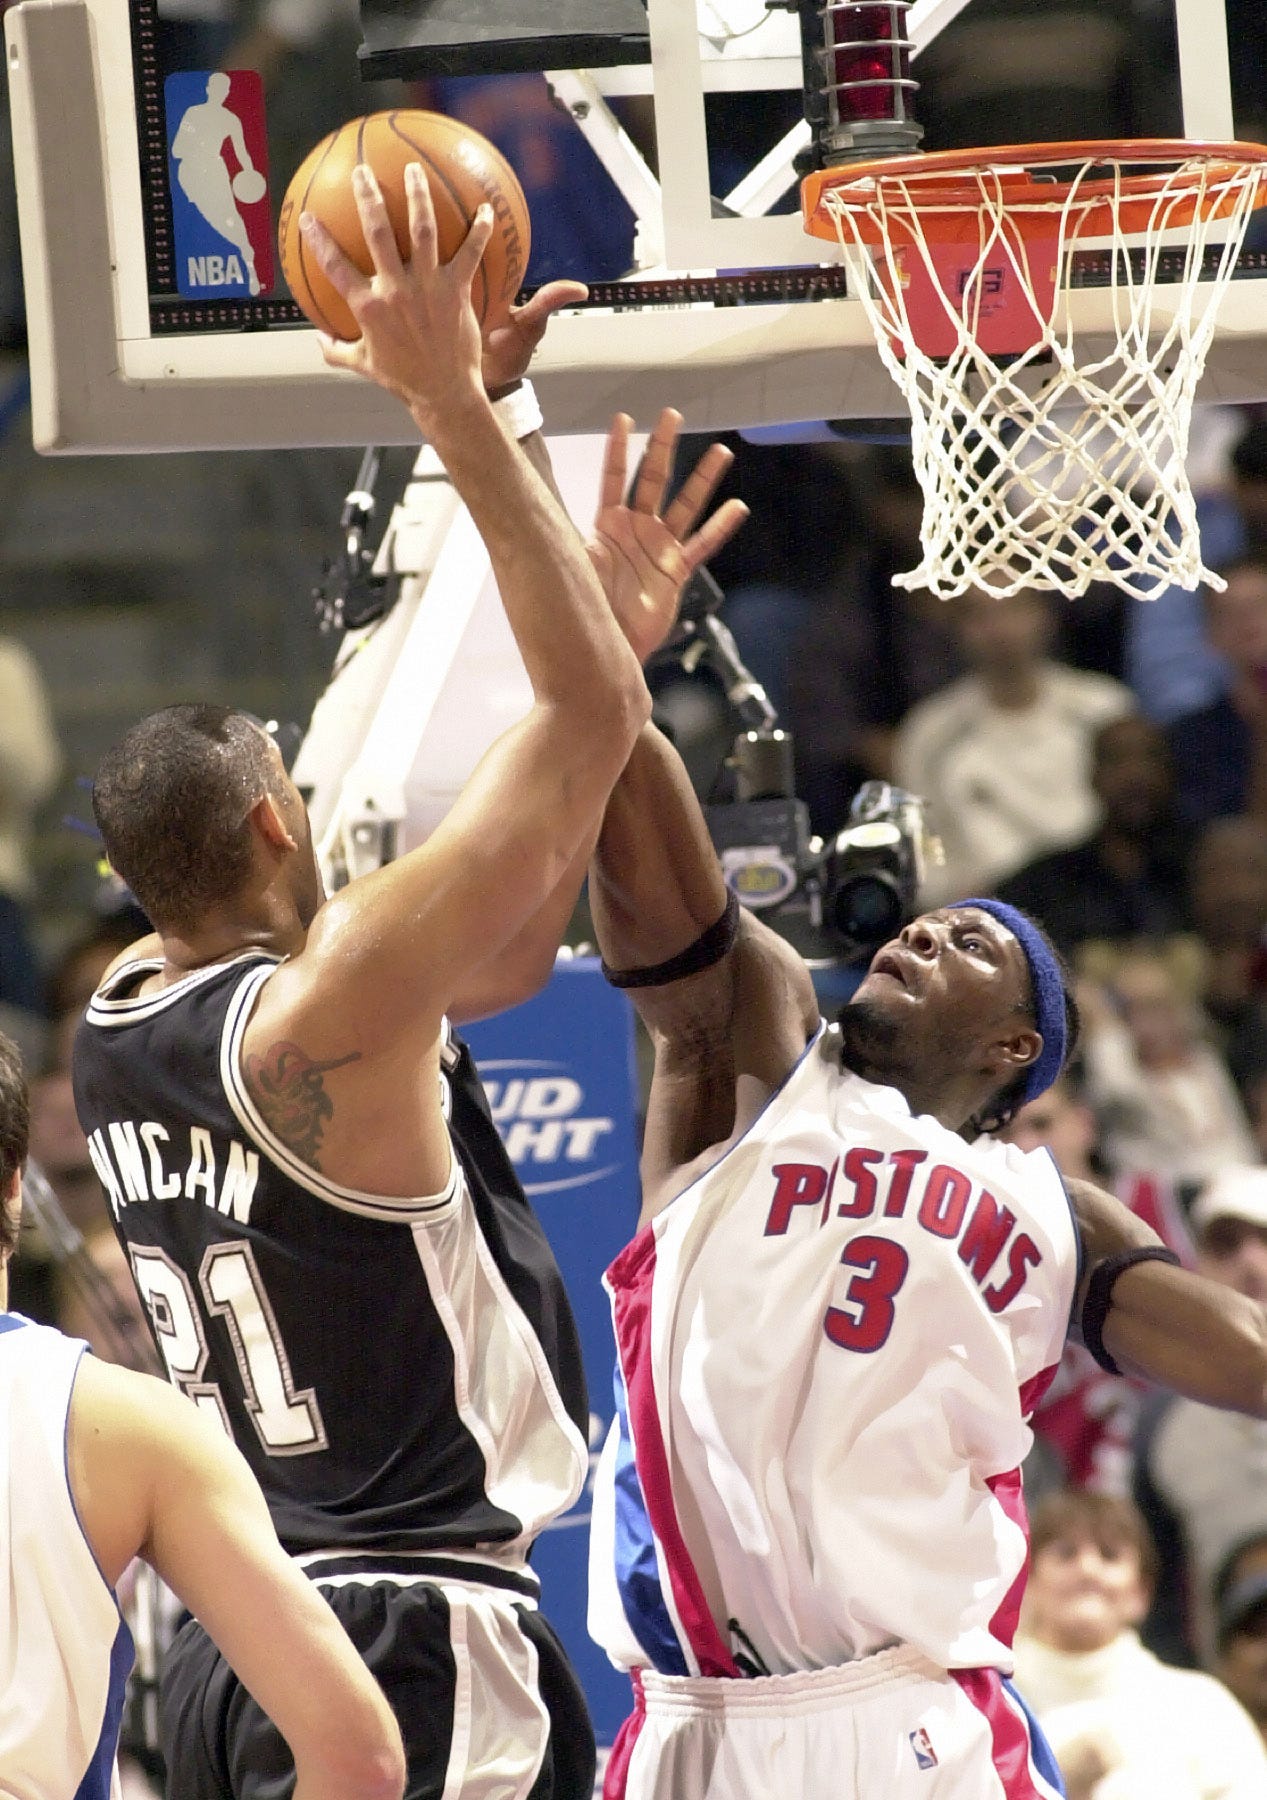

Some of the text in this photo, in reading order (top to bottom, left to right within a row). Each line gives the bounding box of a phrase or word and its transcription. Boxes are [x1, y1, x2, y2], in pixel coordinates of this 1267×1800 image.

[187, 254, 244, 286] NBA
[482, 1076, 583, 1121] UD
[823, 1235, 909, 1353] 3
[127, 1239, 330, 1457] 21
